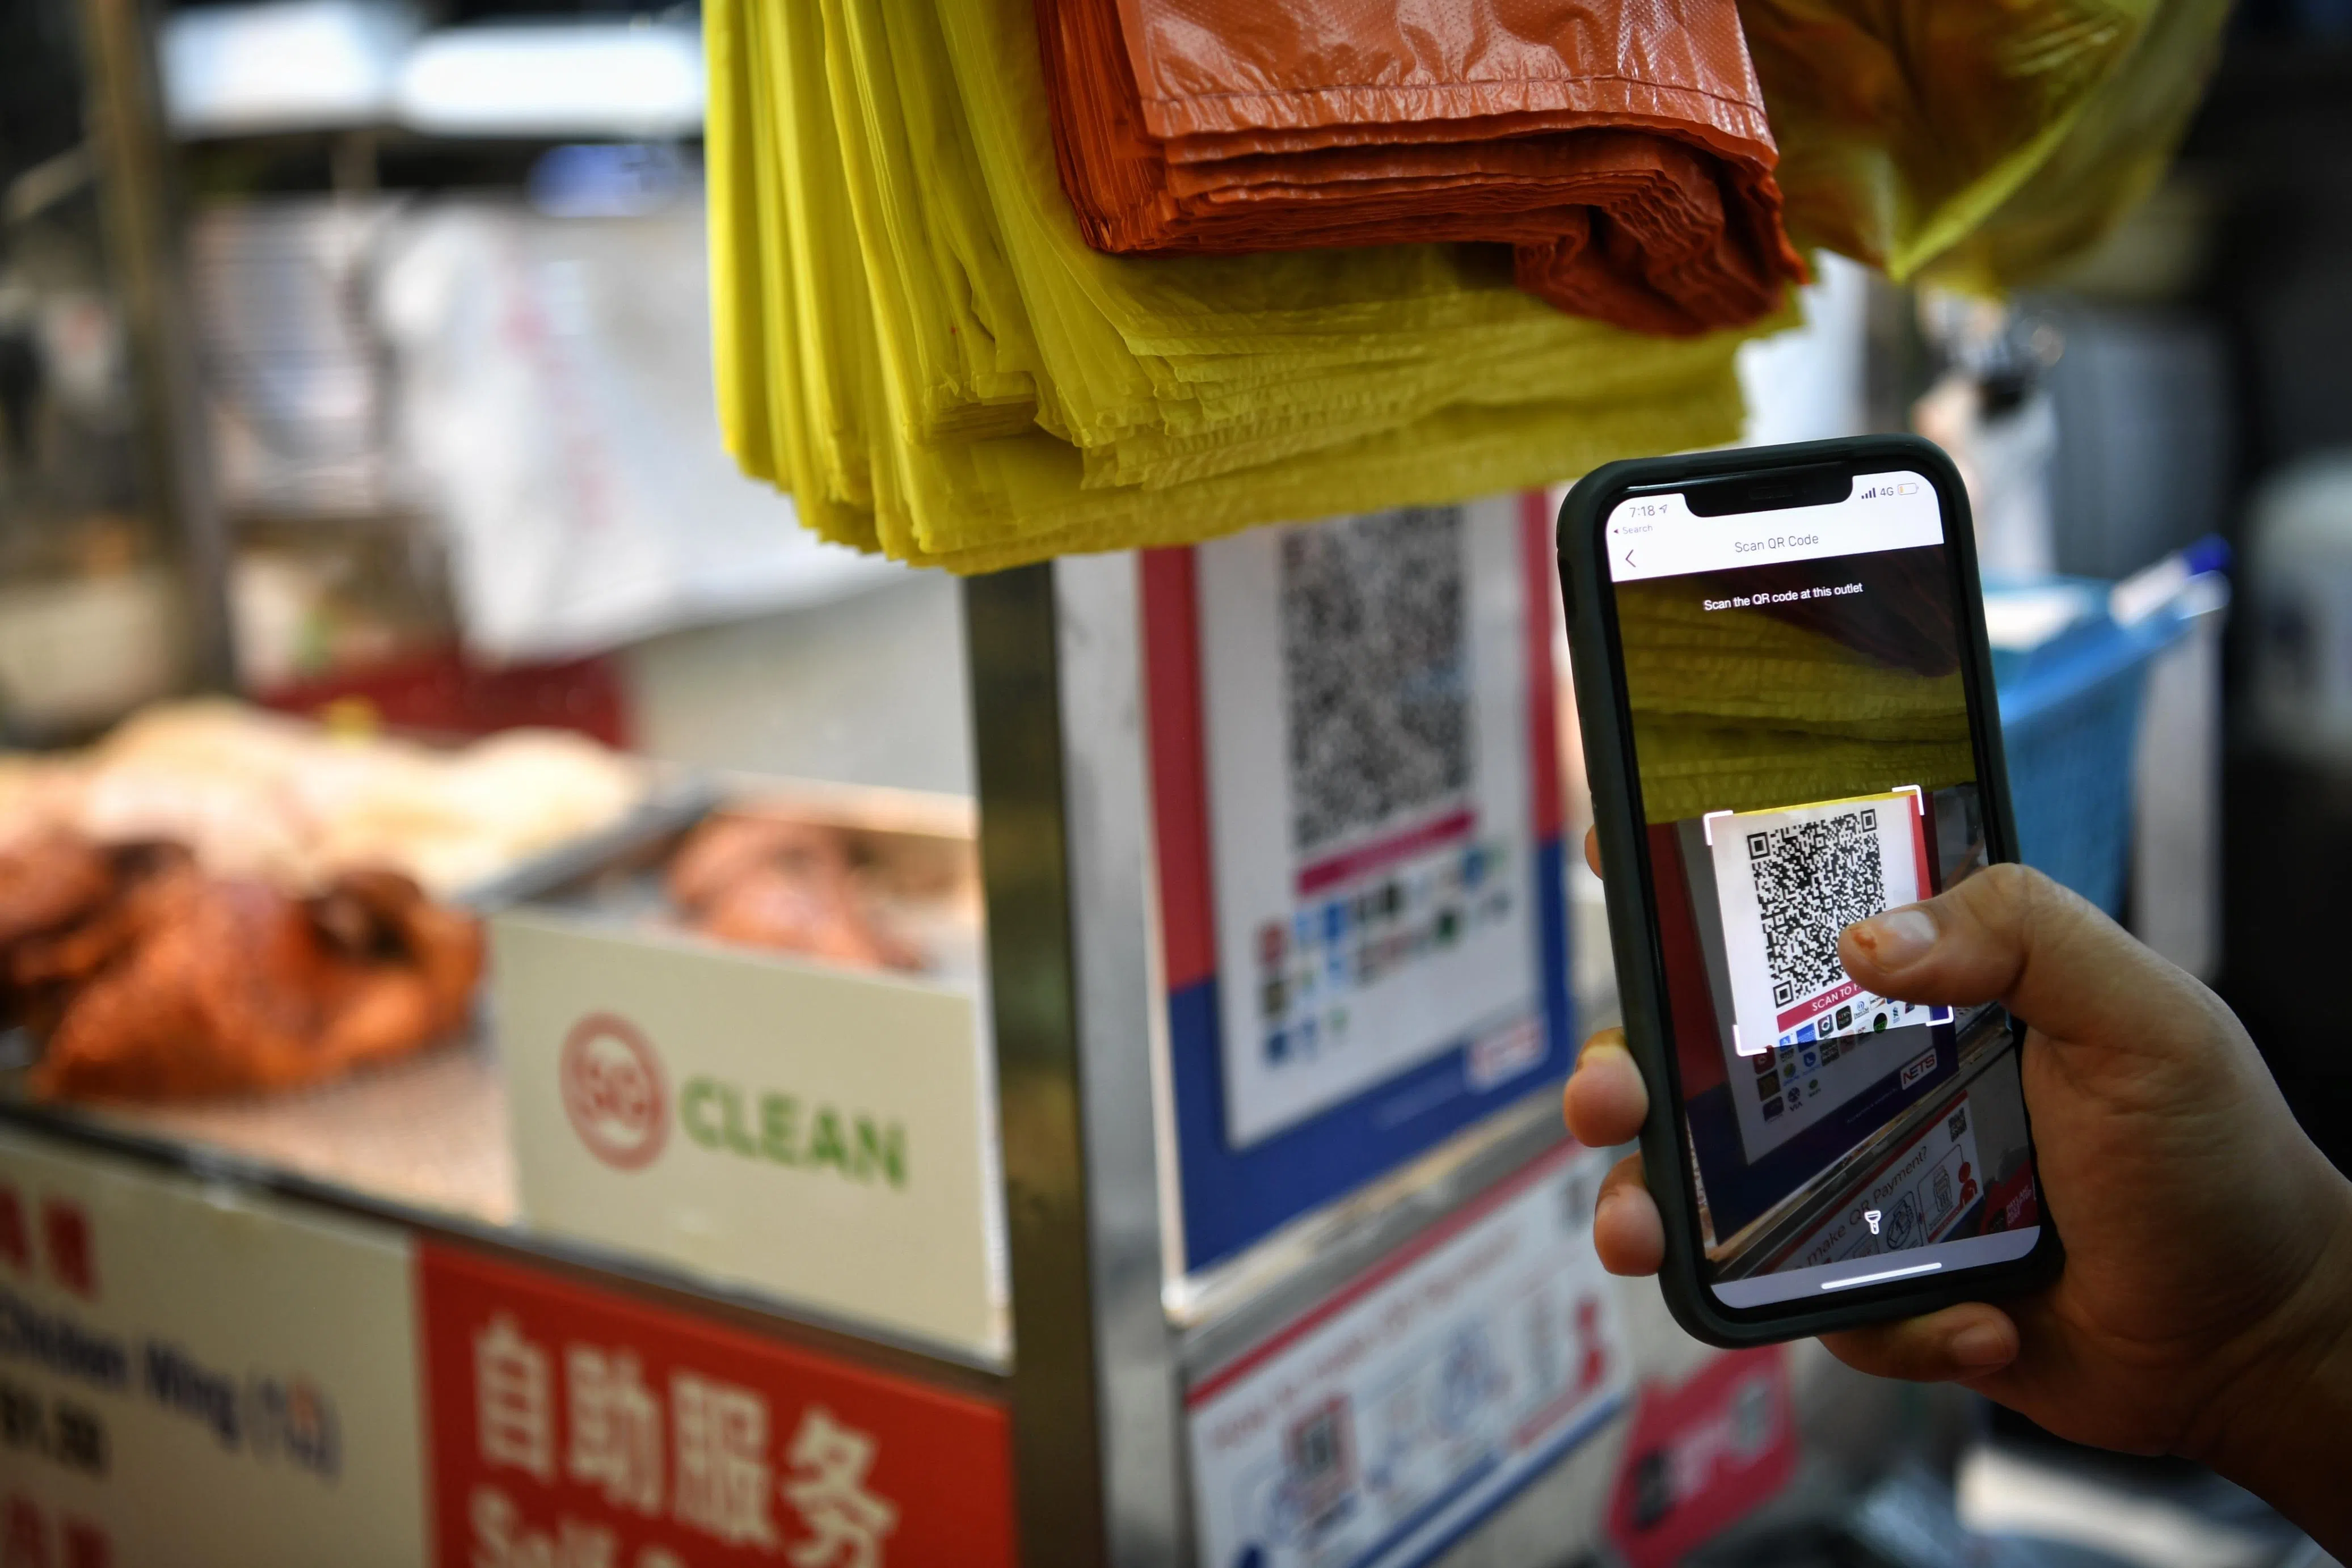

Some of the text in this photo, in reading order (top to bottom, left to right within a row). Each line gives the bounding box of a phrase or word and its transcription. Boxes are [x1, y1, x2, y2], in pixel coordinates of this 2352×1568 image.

[1880, 487, 1894, 496] 4G
[1629, 505, 1655, 517] 7:18
[1622, 524, 1653, 534] Search
[1734, 534, 1819, 553] Scan QR Code
[1704, 582, 1864, 610] Scan the QR code at this outlet
[1812, 992, 1839, 1011] SCAN
[1839, 986, 1852, 998] TO
[1903, 1054, 1935, 1085] NETS
[681, 1075, 911, 1188] CLEAN
[1807, 1145, 1927, 1266] make QR Payment?
[471, 1312, 900, 1568] 自助服务
